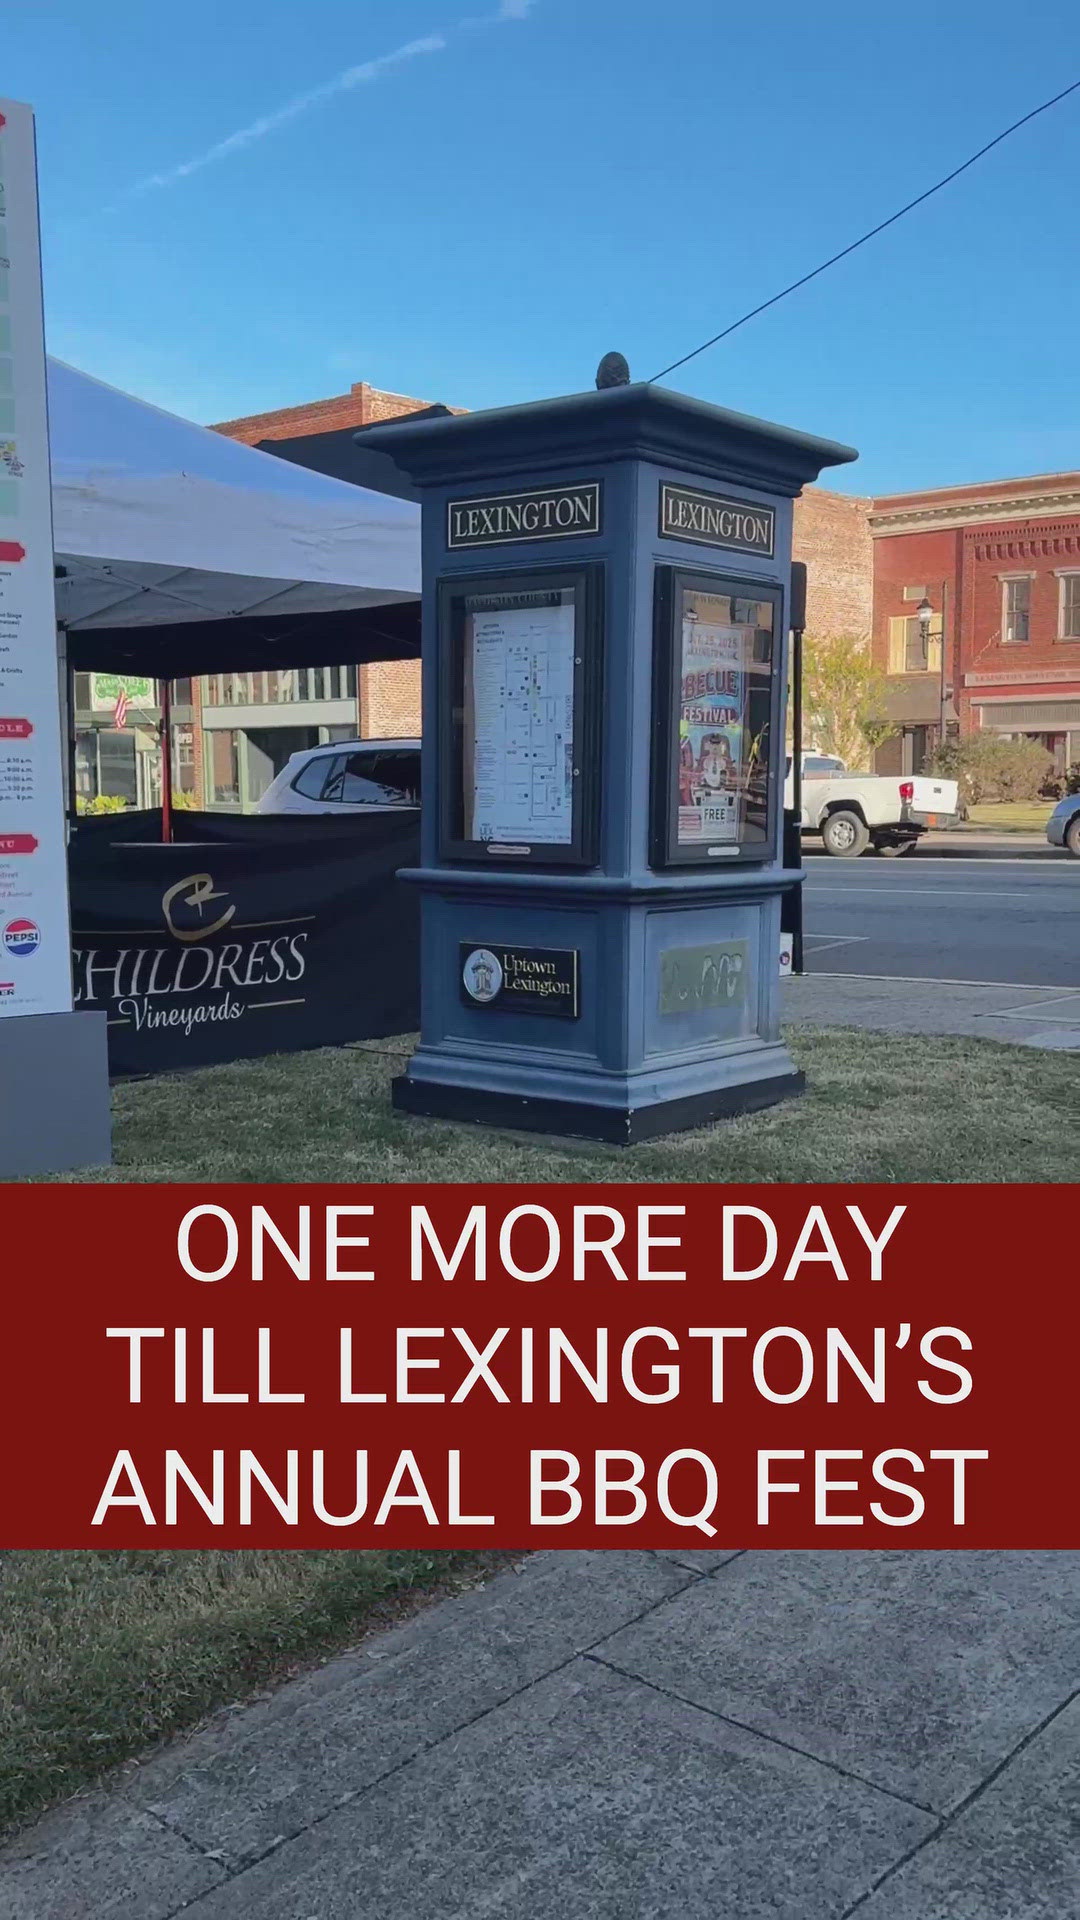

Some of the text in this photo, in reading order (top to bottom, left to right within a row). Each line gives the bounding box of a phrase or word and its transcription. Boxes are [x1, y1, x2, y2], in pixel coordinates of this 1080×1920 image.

[455, 494, 593, 538] LEXINGTON
[667, 496, 769, 545] LEXINGTON
[683, 706, 736, 724] FESTIVAL
[704, 808, 726, 820] FREE
[5, 932, 39, 943] PEPSI
[503, 954, 556, 976] Uptown
[504, 972, 572, 996] Lexington
[118, 991, 245, 1036] Vineyards
